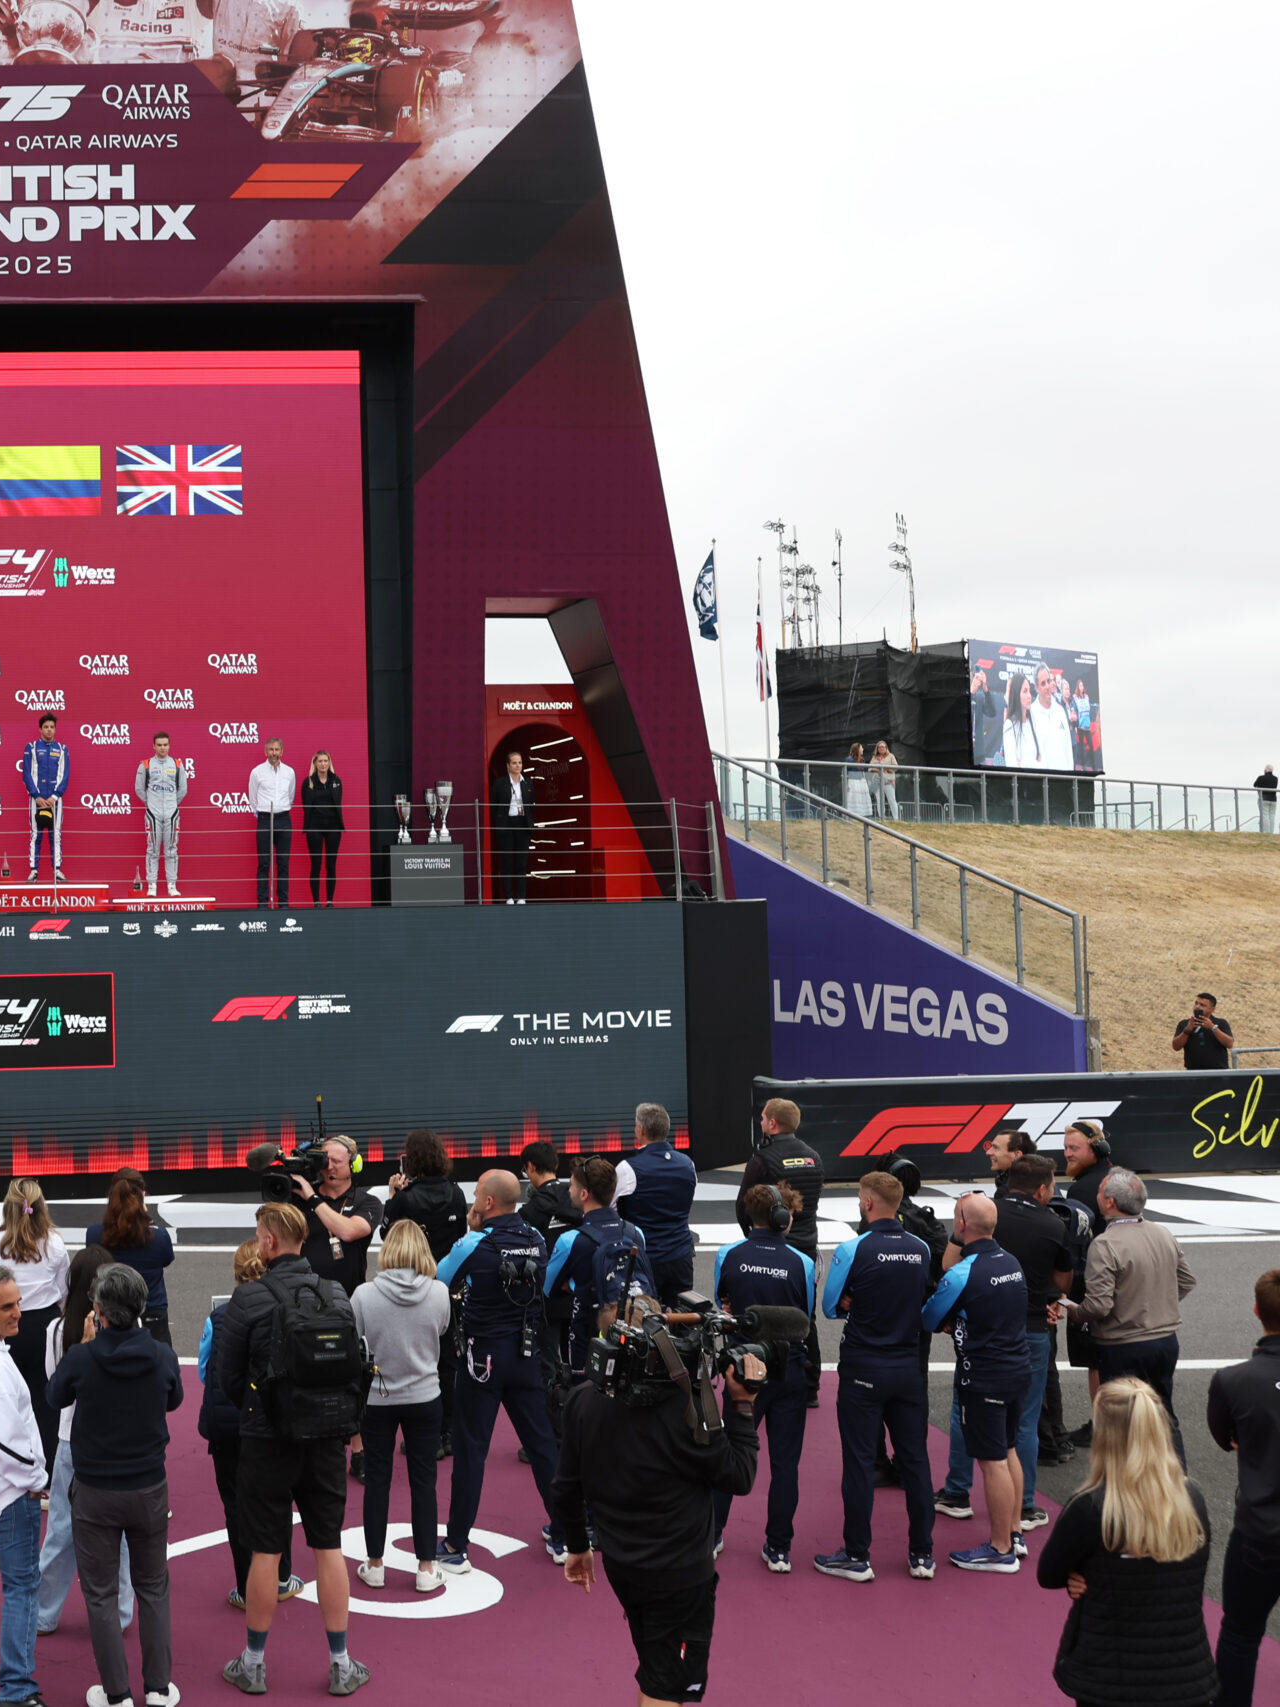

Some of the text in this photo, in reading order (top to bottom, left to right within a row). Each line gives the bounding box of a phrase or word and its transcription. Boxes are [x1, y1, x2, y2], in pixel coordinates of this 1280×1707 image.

[102, 84, 190, 109] QATAR
[123, 107, 191, 120] AIRWAYS
[16, 135, 81, 152] QATAR
[88, 134, 178, 149] AIRWAYS
[69, 205, 196, 242] PRIX
[71, 565, 115, 579] Wera
[79, 655, 129, 669] QATAR
[207, 654, 257, 669] QATAR
[15, 690, 65, 705] QATAR
[144, 689, 194, 703] QATAR
[27, 703, 65, 711] AIRWAYS
[503, 701, 526, 710] MOËT
[533, 702, 572, 710] CHANDON
[80, 724, 129, 739] QATAR
[208, 723, 258, 738] QATAR
[92, 737, 130, 745] AIRWAYS
[81, 794, 131, 808] QATAR
[210, 793, 250, 807] QATA
[222, 805, 256, 813] AIRWA
[21, 896, 30, 907] &
[32, 896, 95, 907] CHANDON
[153, 904, 160, 912] &
[123, 923, 140, 931] aws
[248, 921, 267, 929] MSC
[298, 999, 332, 1007] BRITISH
[298, 1005, 351, 1014] GRAND PRIX
[773, 979, 1009, 1046] LAS VEGAS
[64, 1014, 107, 1028] Wera
[513, 1012, 571, 1031] THE
[582, 1009, 672, 1029] MOVIE
[510, 1035, 609, 1046] ONLY IN CINEMAS
[1191, 1075, 1280, 1159] Silv
[885, 1253, 921, 1262] VIRTUOSI
[748, 1264, 788, 1277] VIRTUOSI
[997, 1272, 1022, 1283] VIRTUOSI
